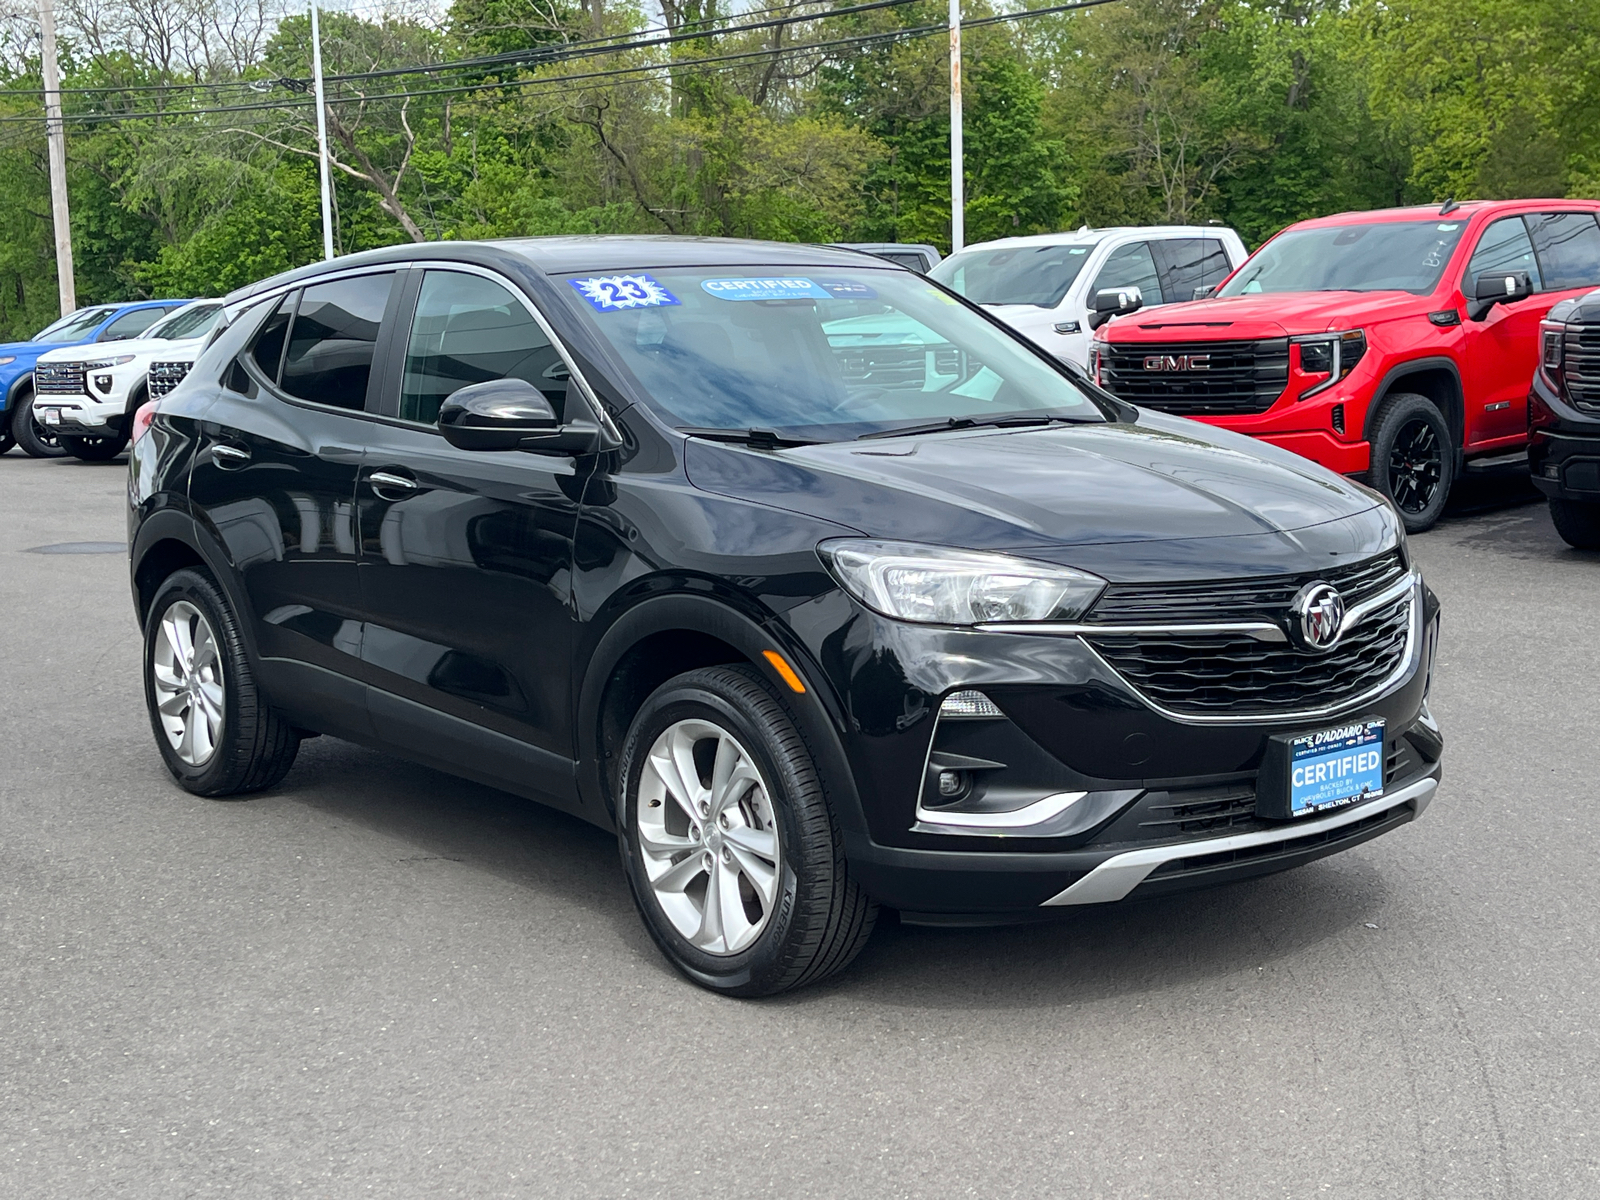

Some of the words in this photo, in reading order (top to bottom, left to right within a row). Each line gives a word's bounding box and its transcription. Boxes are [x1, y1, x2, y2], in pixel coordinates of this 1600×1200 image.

[600, 280, 648, 302] 23
[706, 280, 812, 291] CERTIFIED
[1143, 354, 1211, 372] GMC
[1294, 736, 1314, 745] BUICK
[1315, 725, 1363, 744] D'ADDARIO
[1367, 720, 1385, 728] GMC
[1292, 751, 1379, 787] CERTIFIED
[1300, 790, 1334, 803] CHEVROLET
[1336, 785, 1354, 795] BUICK
[1360, 780, 1374, 788] GMC
[1320, 781, 1343, 791] BACKED
[1293, 807, 1314, 816] NISSAN
[1351, 794, 1361, 802] CT
